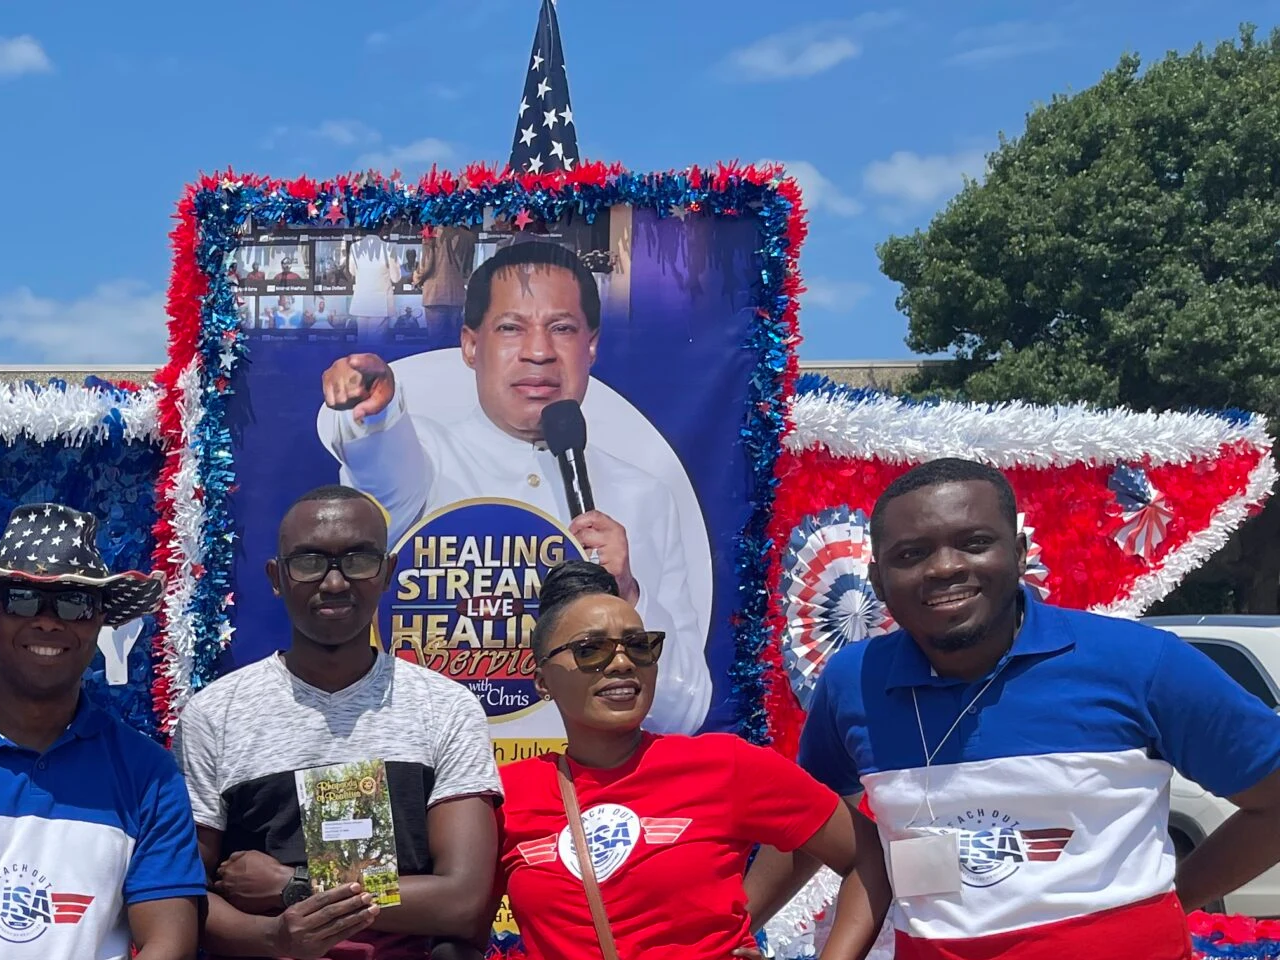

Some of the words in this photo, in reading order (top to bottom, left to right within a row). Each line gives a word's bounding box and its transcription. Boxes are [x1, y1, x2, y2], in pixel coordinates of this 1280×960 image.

[414, 536, 564, 568] HEALING
[397, 568, 552, 600] STREAM
[467, 599, 513, 617] LIVE
[392, 636, 537, 676] Servic
[469, 678, 492, 692] with
[487, 687, 529, 706] Chris
[991, 809, 1020, 828] OUT
[31, 869, 53, 889] OUT
